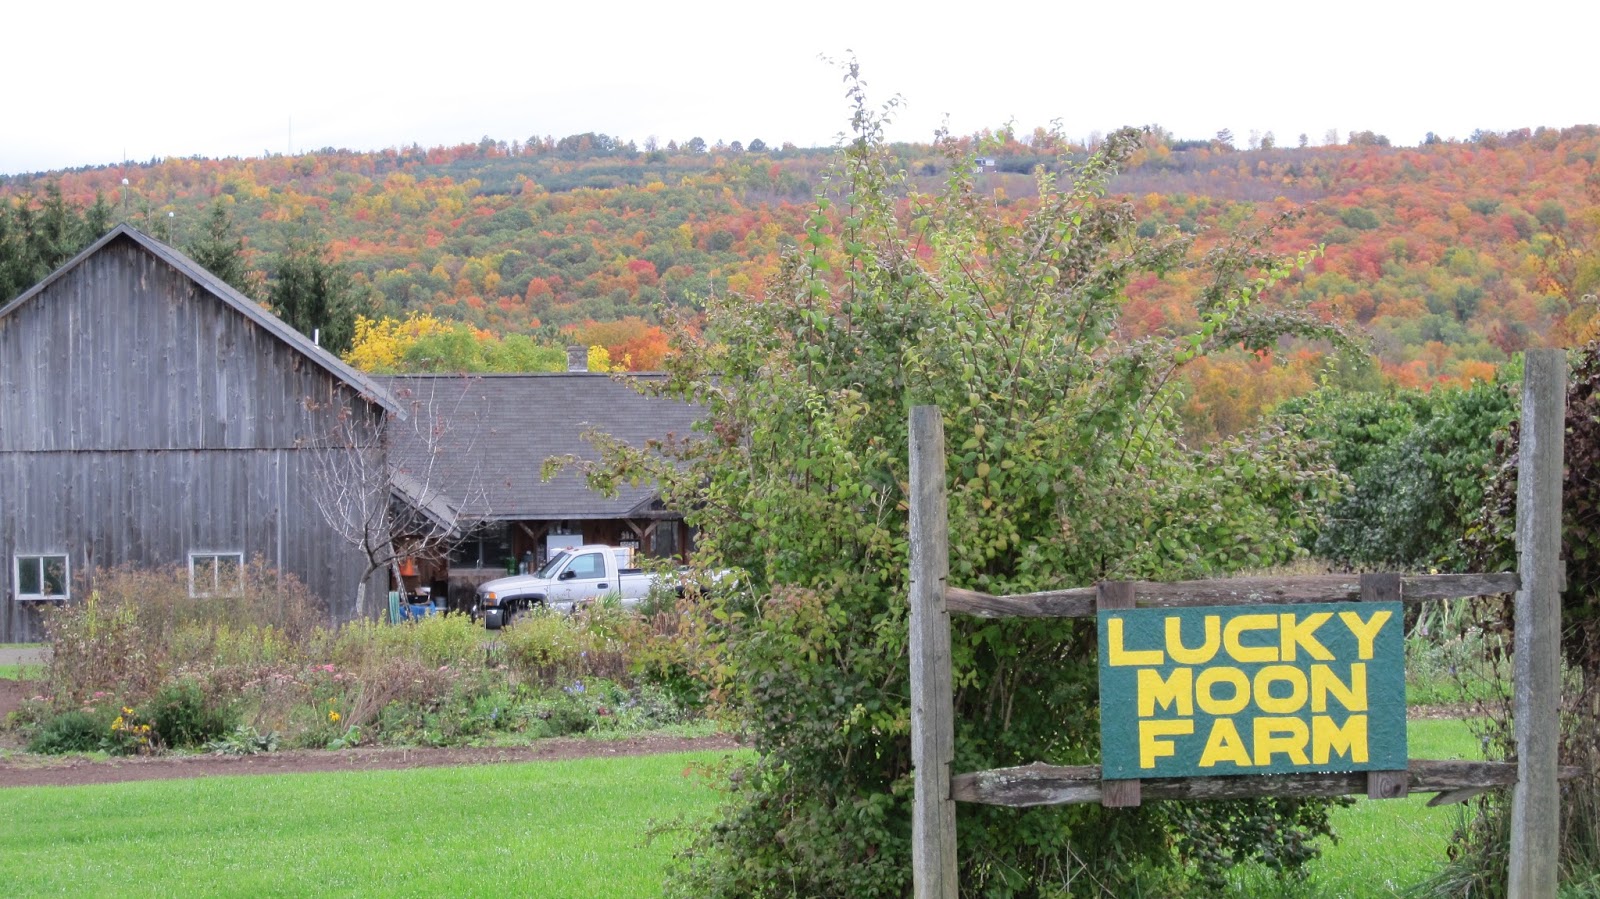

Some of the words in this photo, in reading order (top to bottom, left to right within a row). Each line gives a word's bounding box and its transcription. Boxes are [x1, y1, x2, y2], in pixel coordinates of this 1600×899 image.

[1107, 610, 1393, 667] LUCKY
[1137, 662, 1368, 717] MOON
[1138, 714, 1369, 769] FARM
